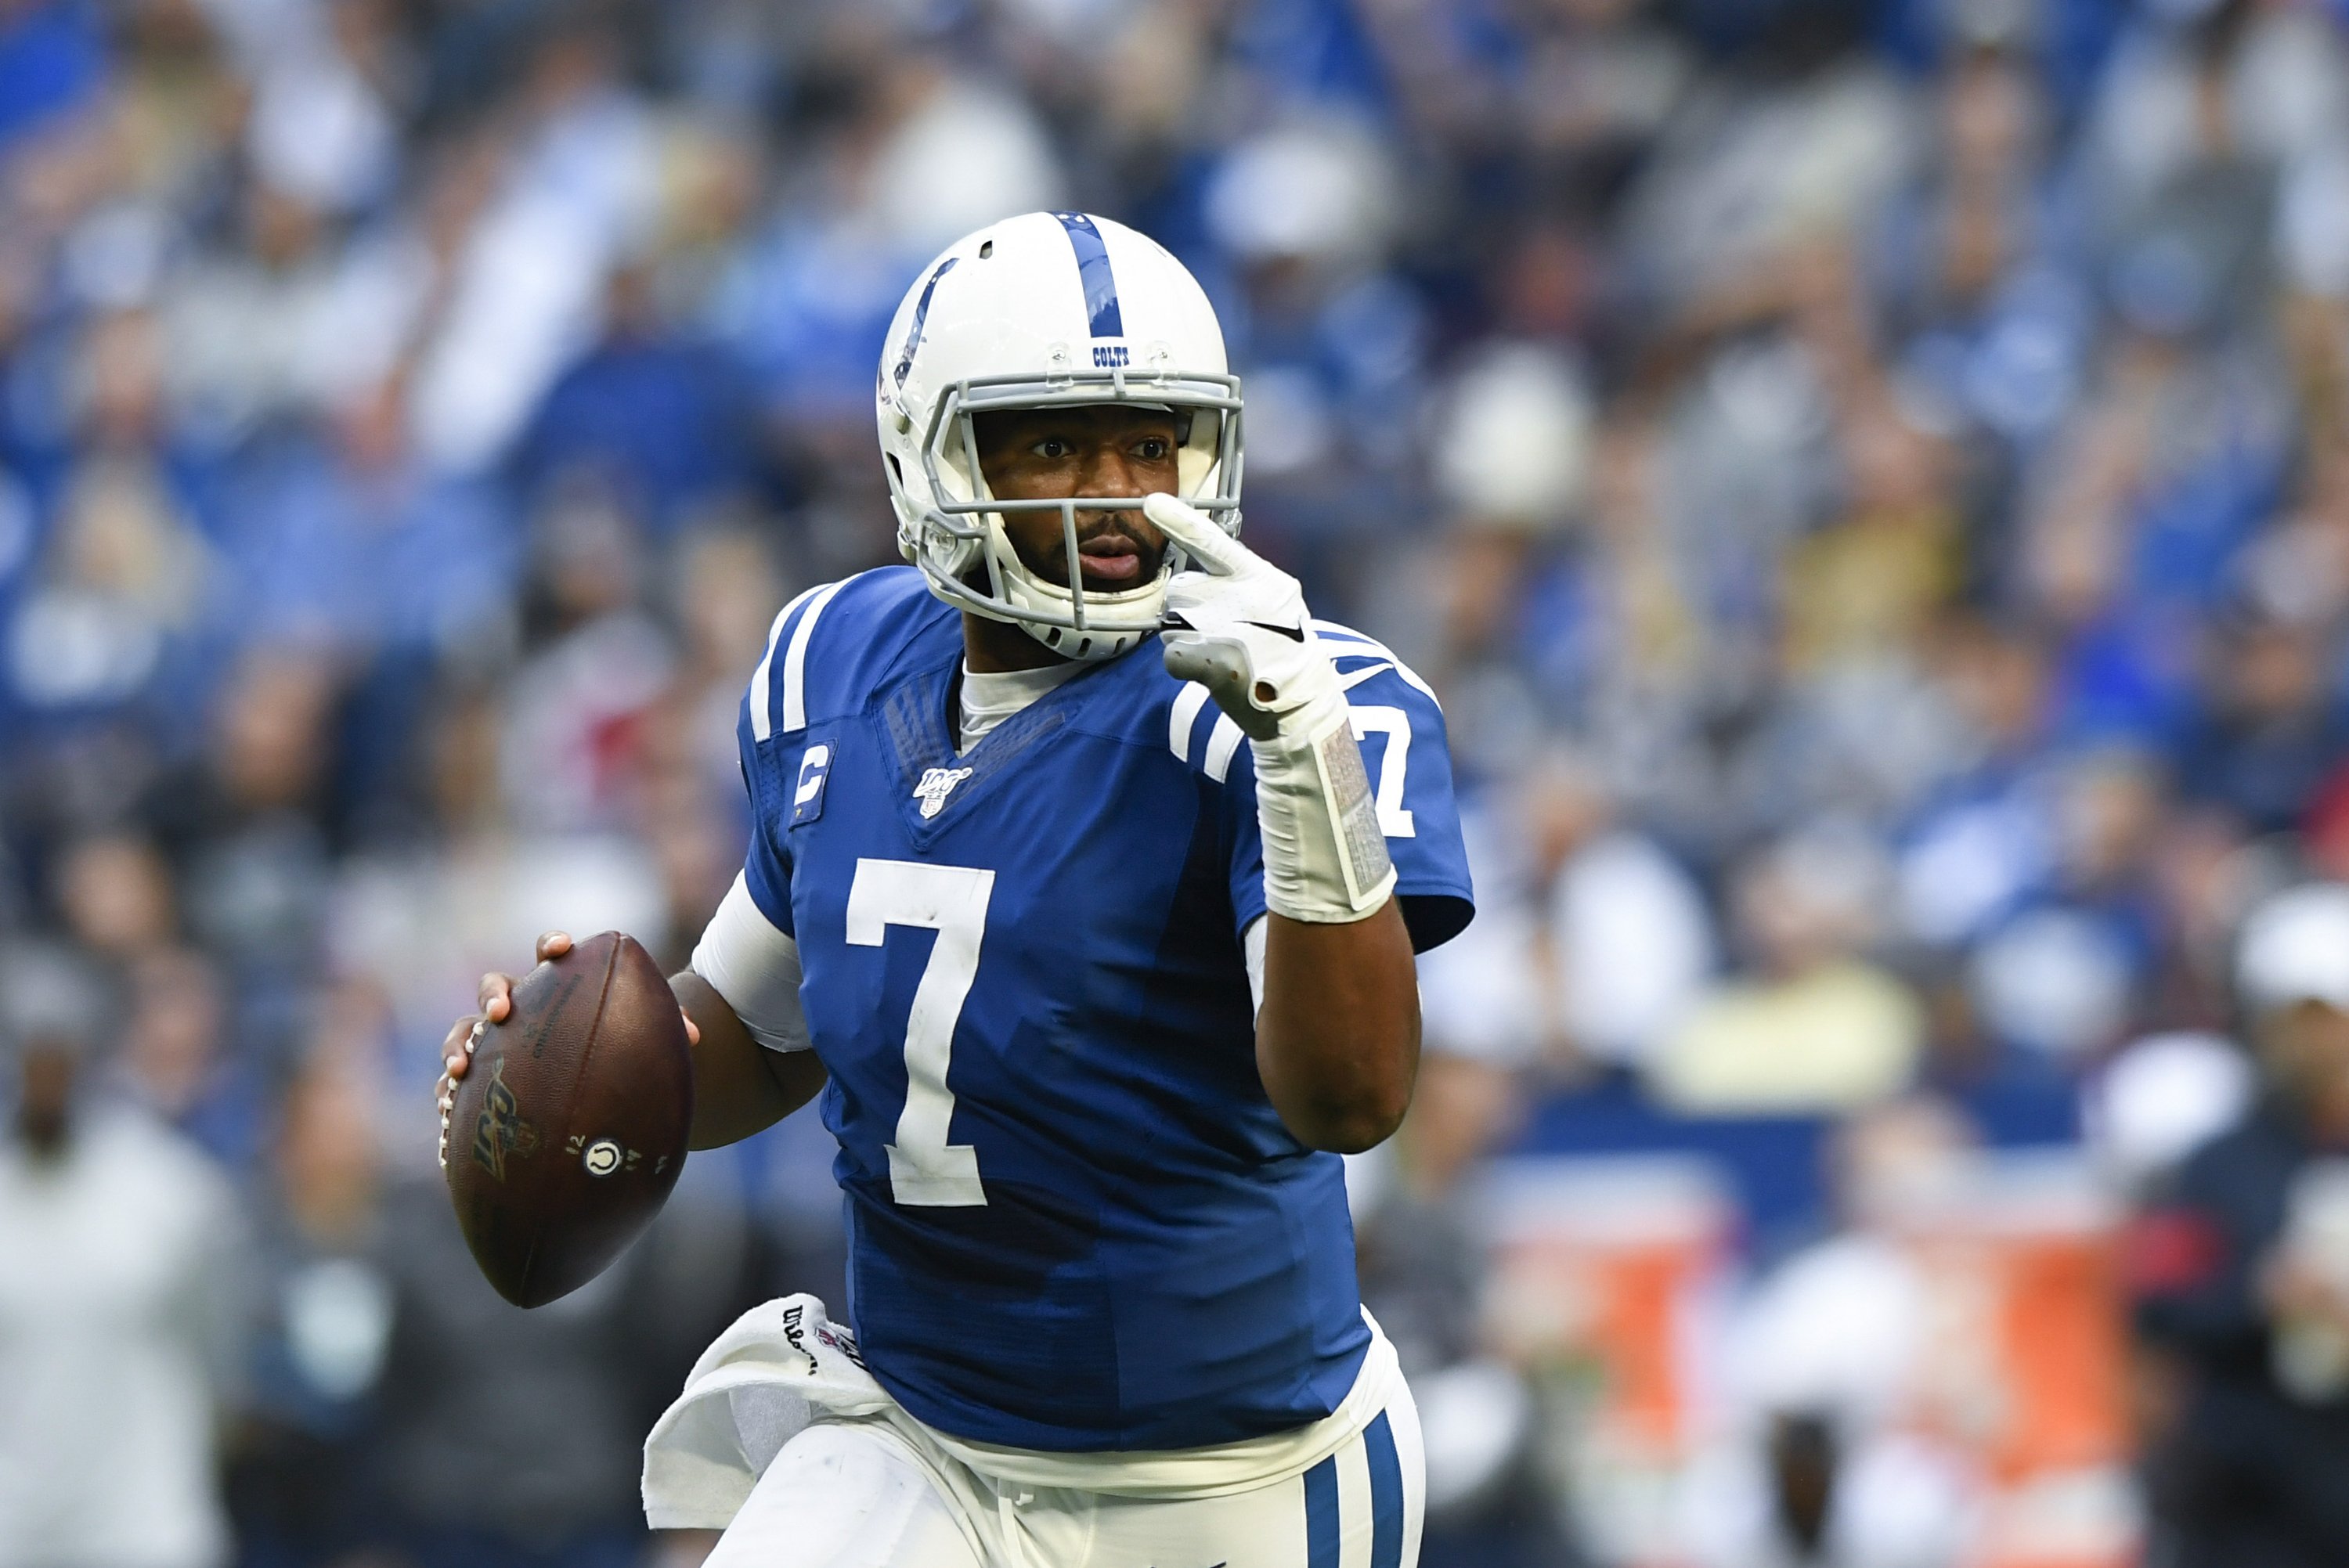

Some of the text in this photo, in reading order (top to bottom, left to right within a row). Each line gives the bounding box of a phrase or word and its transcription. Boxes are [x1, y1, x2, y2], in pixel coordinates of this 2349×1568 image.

[1093, 347, 1130, 367] COLTS
[793, 744, 828, 806] C
[1348, 705, 1416, 838] 7
[846, 858, 996, 1206] 7
